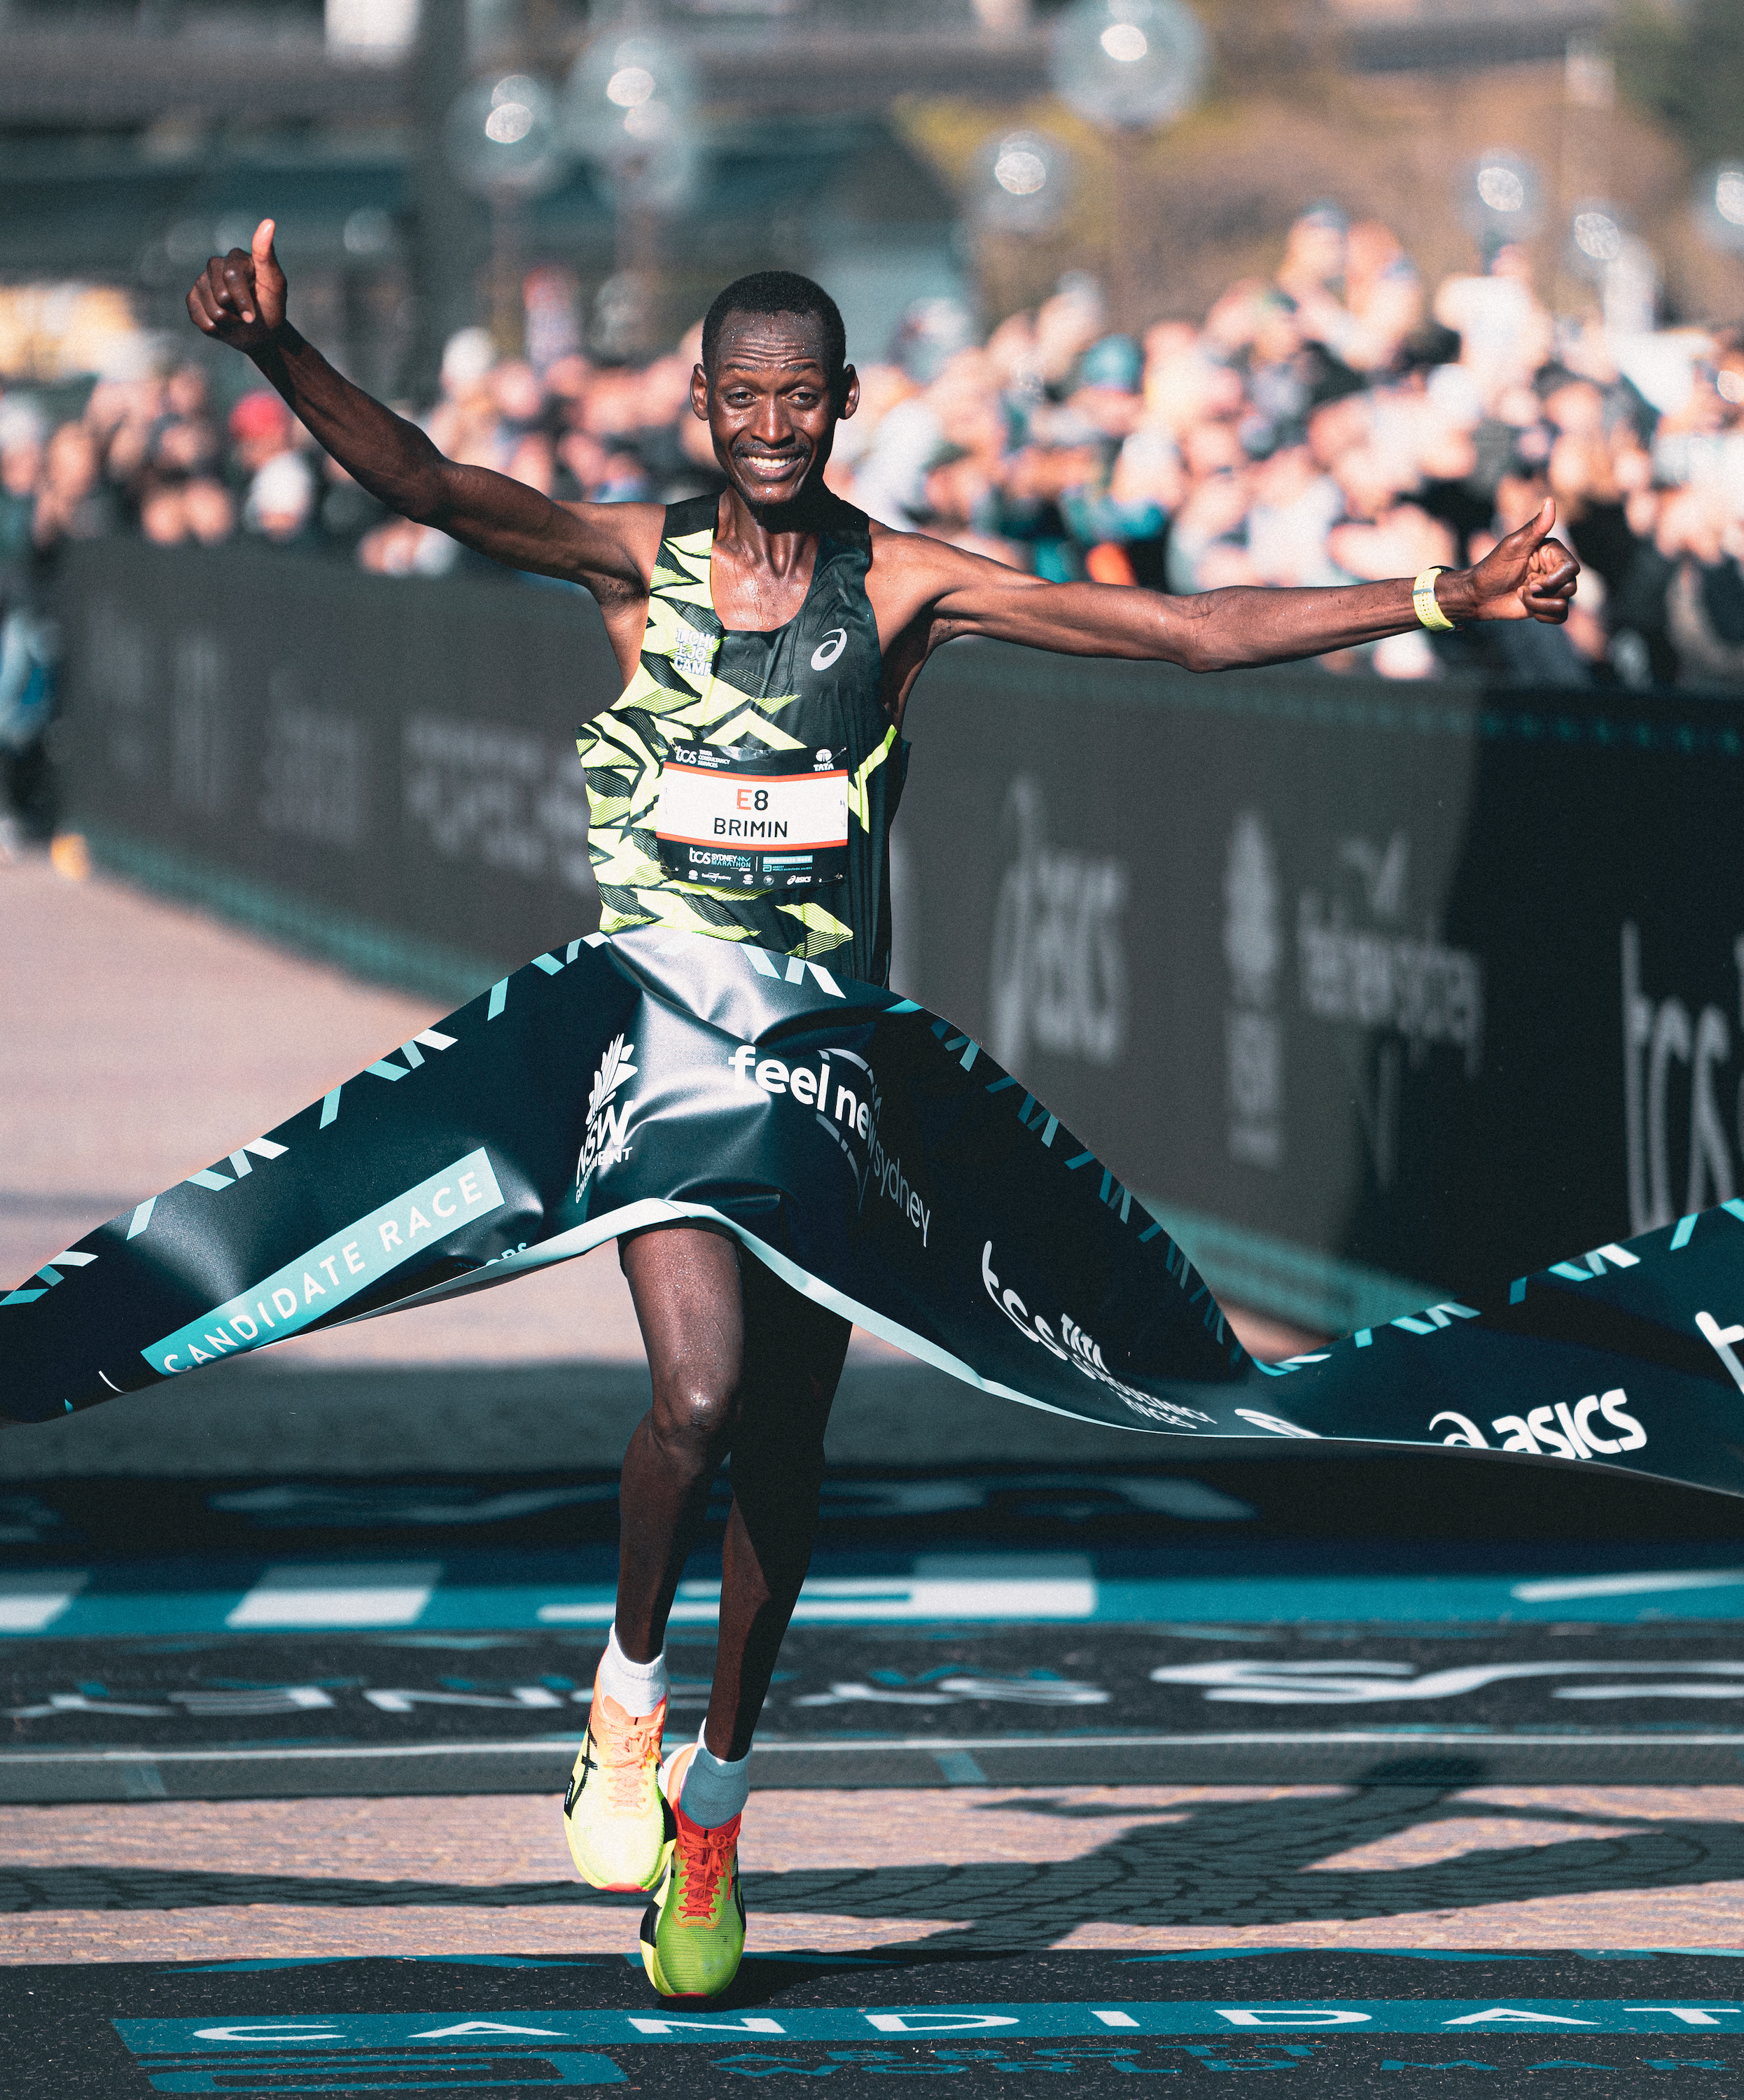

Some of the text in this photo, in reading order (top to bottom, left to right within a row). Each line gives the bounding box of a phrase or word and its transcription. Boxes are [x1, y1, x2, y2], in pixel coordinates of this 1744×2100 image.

[676, 746, 697, 764] tcs
[698, 755, 731, 765] CONSULTANCY
[814, 763, 835, 772] TATA
[737, 788, 769, 811] E8
[713, 817, 788, 839] BRIMIN
[689, 847, 711, 865] tcs
[711, 853, 738, 862] SYDNEY
[711, 860, 751, 868] MARATHON
[576, 1100, 634, 1187] NSW
[727, 1046, 930, 1248] feel new sydney
[163, 1171, 483, 1376] CANDIDATE RACE
[982, 1240, 1068, 1361] tcs
[1060, 1312, 1112, 1376] TATA
[1491, 1388, 1648, 1461] asics
[191, 2007, 1741, 2041] CANDIDAT
[709, 2044, 1330, 2064] ABBOTT
[713, 2059, 1302, 2078] WORLD
